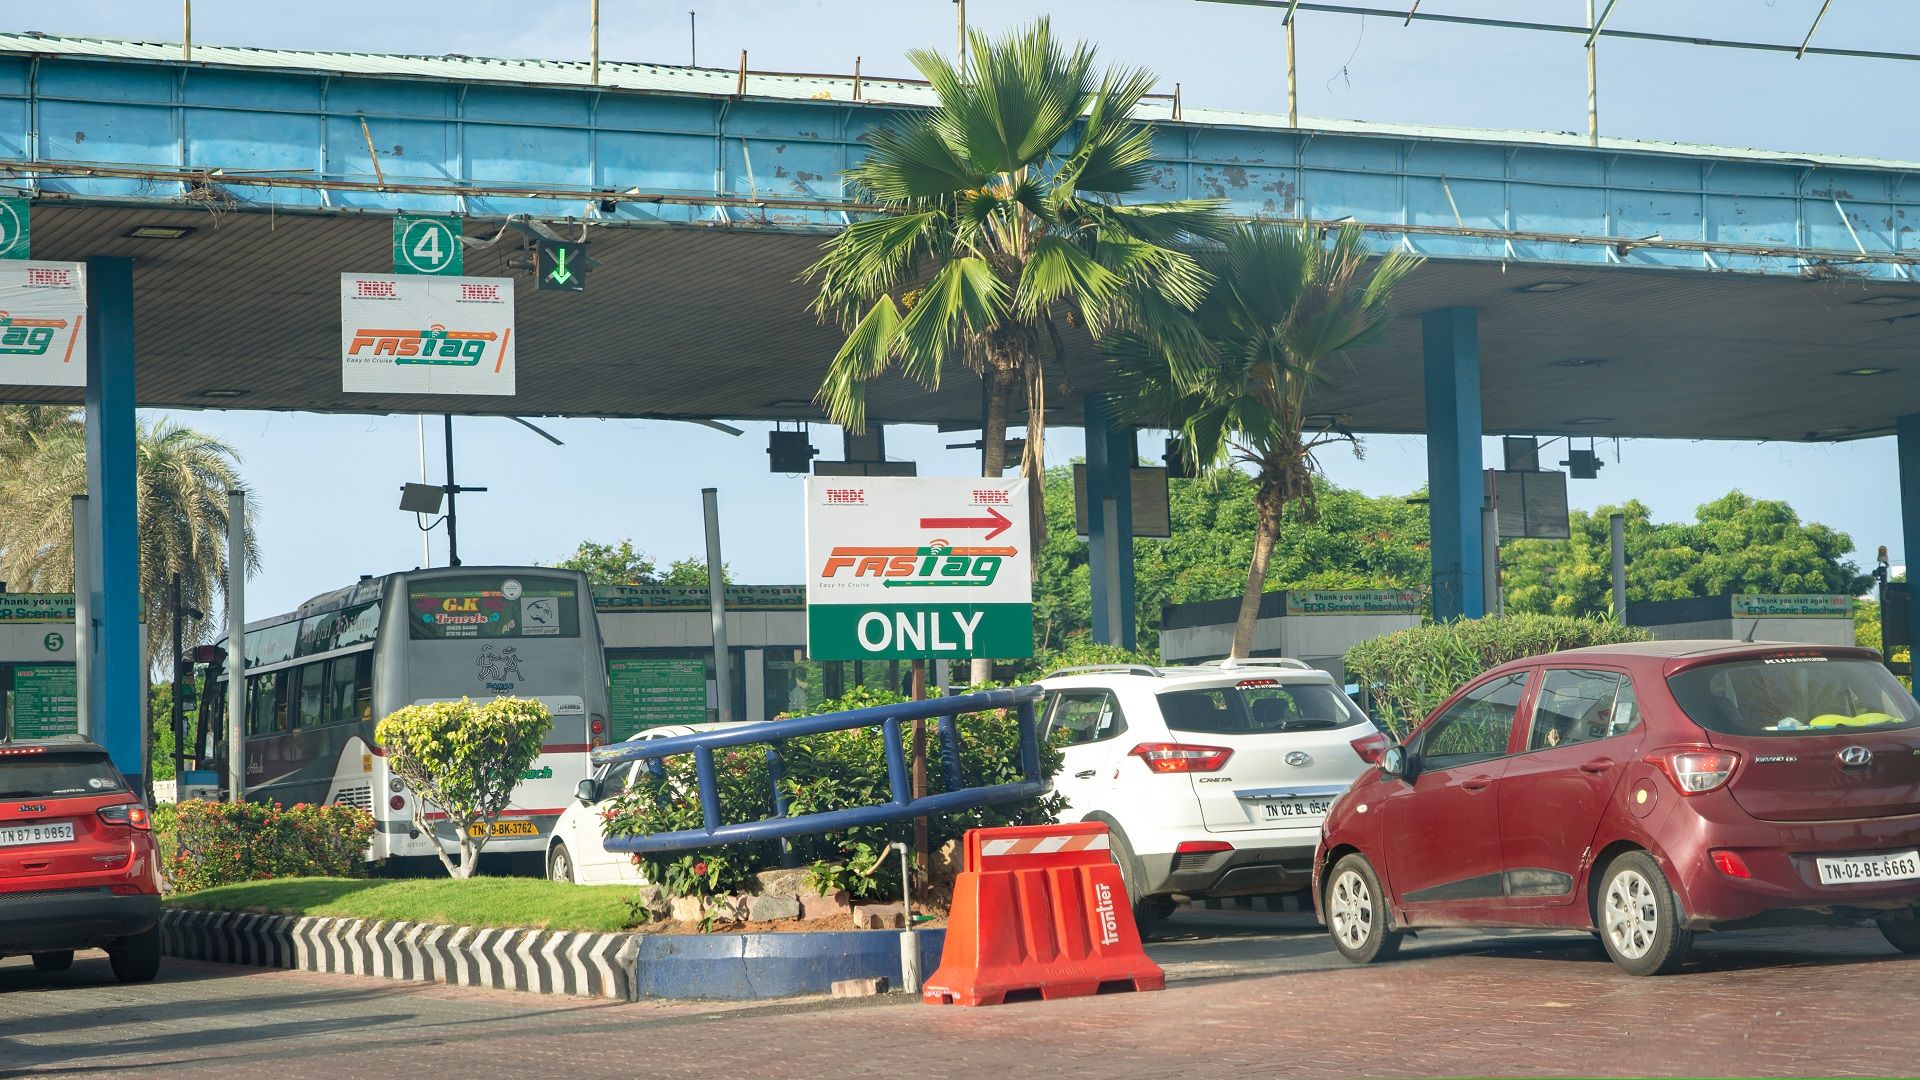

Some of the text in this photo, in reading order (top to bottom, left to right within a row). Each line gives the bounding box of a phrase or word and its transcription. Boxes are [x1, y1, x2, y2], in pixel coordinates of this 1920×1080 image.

[413, 226, 444, 265] 4
[356, 280, 396, 296] TNRDC
[461, 284, 500, 299] TNRDC
[826, 489, 865, 503] TNRDC
[973, 490, 1009, 504] TNRDC
[821, 546, 1008, 587] FASTag
[617, 587, 806, 597] Thank you isit again
[1374, 593, 1395, 601] again
[33, 599, 51, 607] you
[442, 597, 480, 611] G.K
[1303, 602, 1326, 612] ECR
[1328, 602, 1360, 611] Scenic
[15, 608, 62, 619] Scenic
[1748, 606, 1767, 615] ECR
[1769, 606, 1798, 615] Scenic
[435, 612, 489, 625] Travels
[857, 611, 985, 651] ONLY
[47, 632, 61, 648] 5
[518, 766, 552, 780] oach
[18, 803, 46, 812] Jeep
[1265, 804, 1279, 817] TN
[1281, 803, 1293, 816] 02
[1295, 803, 1308, 815] BL
[1, 826, 72, 842] TN 87 B 0852
[471, 823, 532, 837] TN-9-BK-3762
[407, 841, 427, 849] STOP
[1824, 858, 1916, 879] TN-02-BE-6663
